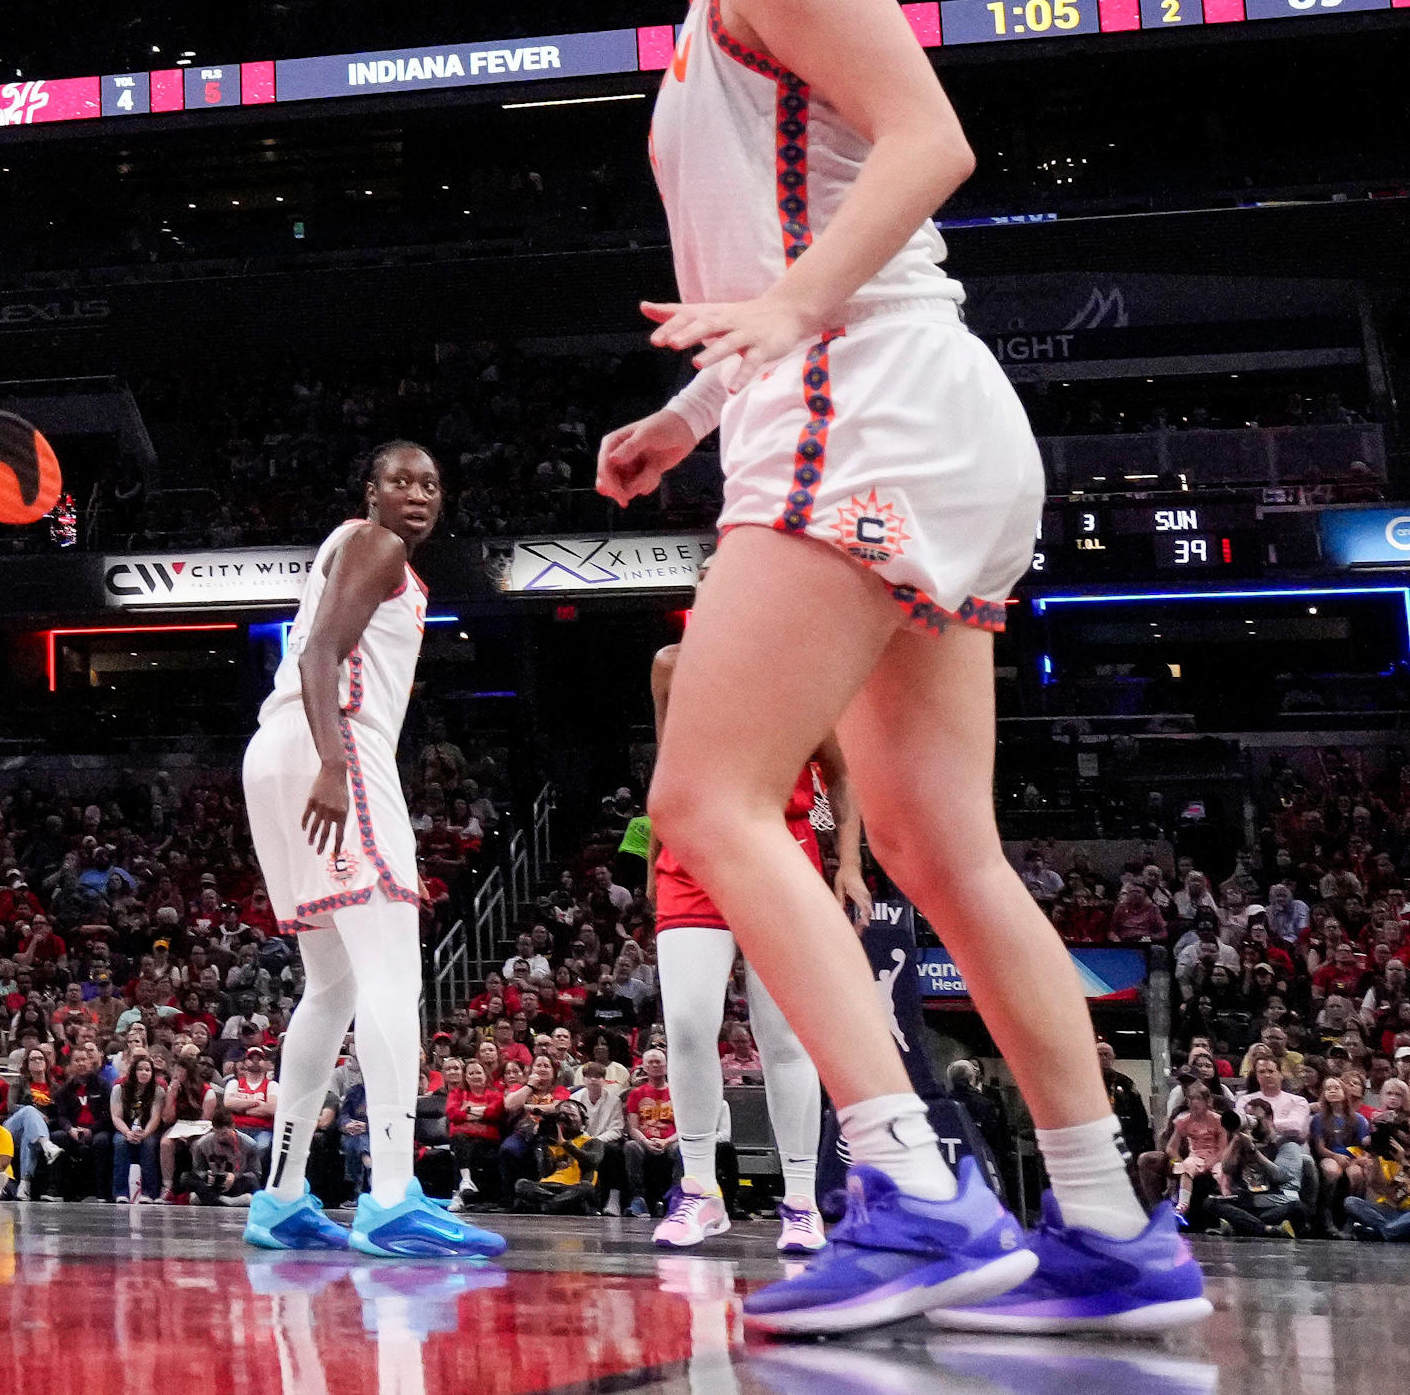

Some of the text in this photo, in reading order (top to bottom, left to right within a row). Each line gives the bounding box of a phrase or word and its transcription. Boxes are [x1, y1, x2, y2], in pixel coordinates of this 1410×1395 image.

[1160, 0, 1182, 23] 2
[201, 69, 223, 80] FLS
[348, 45, 561, 86] INDIANA FEVER
[116, 90, 135, 111] 4
[204, 82, 221, 104] 5
[997, 335, 1075, 360] IGHT
[1083, 514, 1096, 532] 3
[1155, 510, 1197, 531] SUN
[1175, 539, 1207, 564] 39
[191, 561, 314, 578] CITY WIDE
